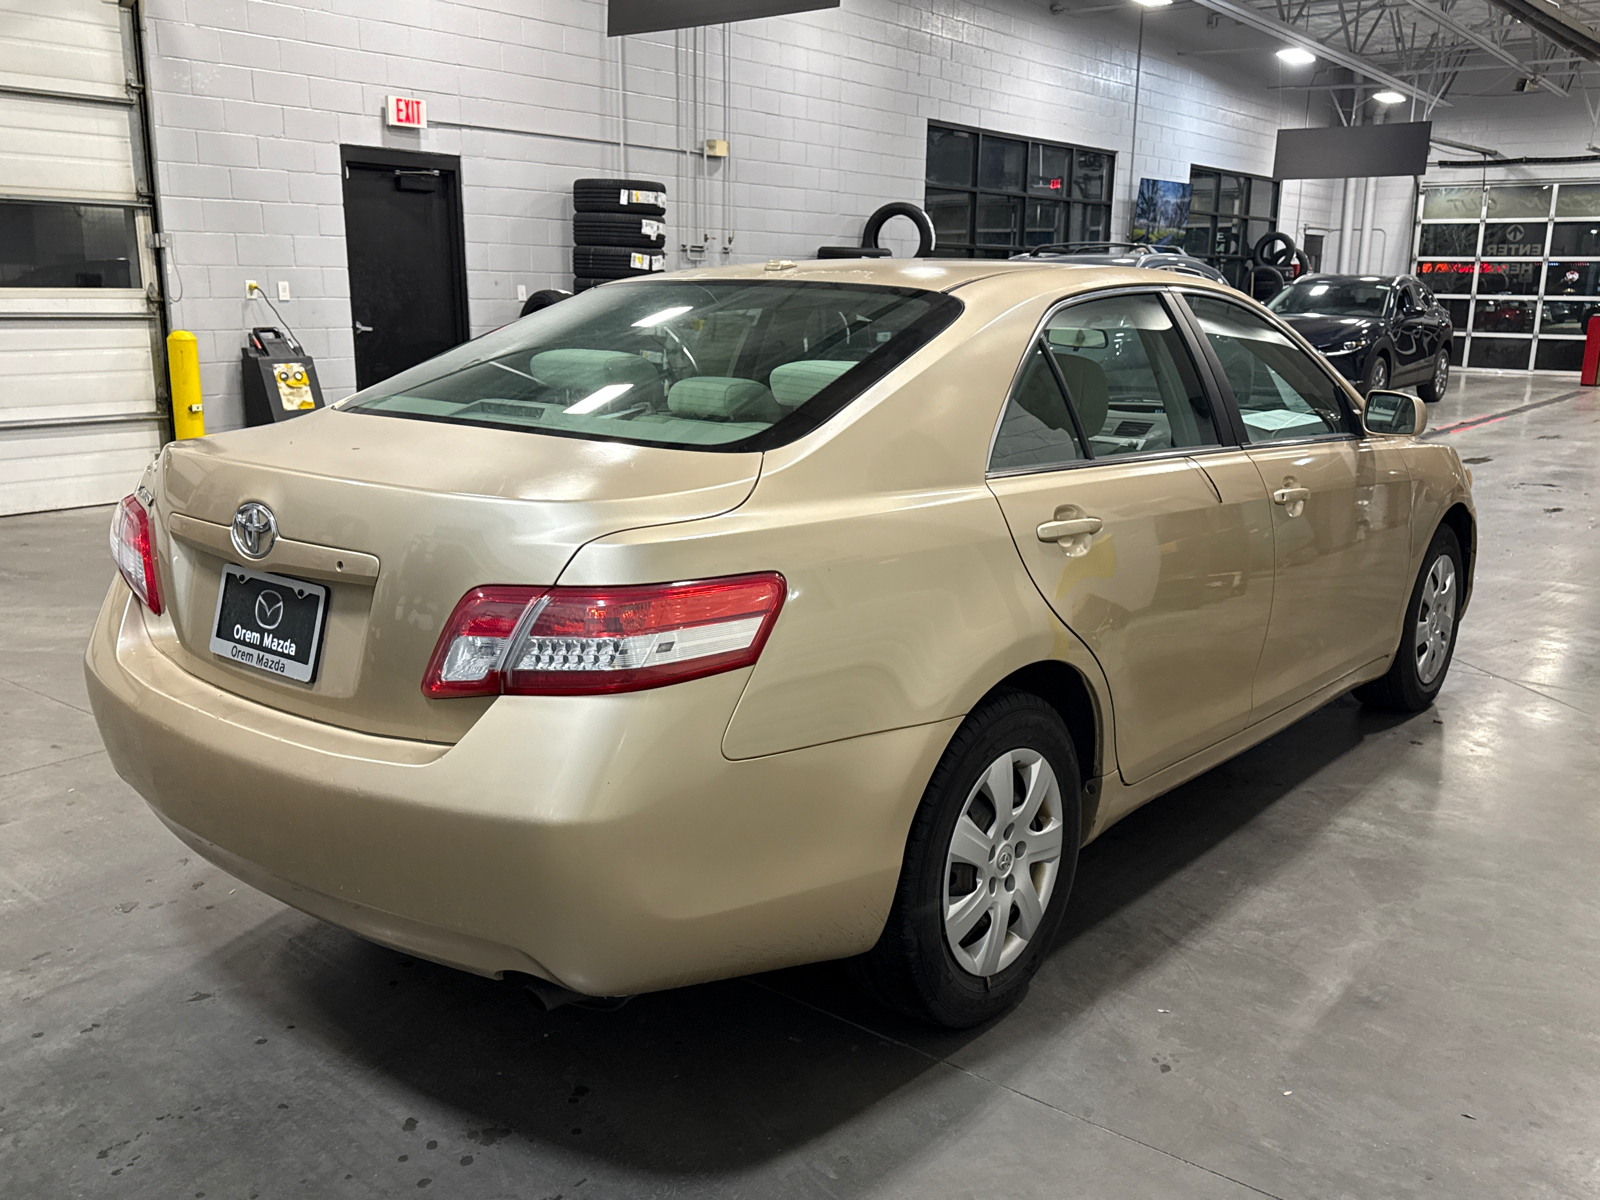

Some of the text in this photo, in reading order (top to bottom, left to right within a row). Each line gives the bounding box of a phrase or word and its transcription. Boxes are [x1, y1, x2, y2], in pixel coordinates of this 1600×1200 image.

[396, 98, 421, 124] EXIT
[234, 624, 296, 656] Orem Mazda
[231, 645, 286, 673] Orem Mazda
